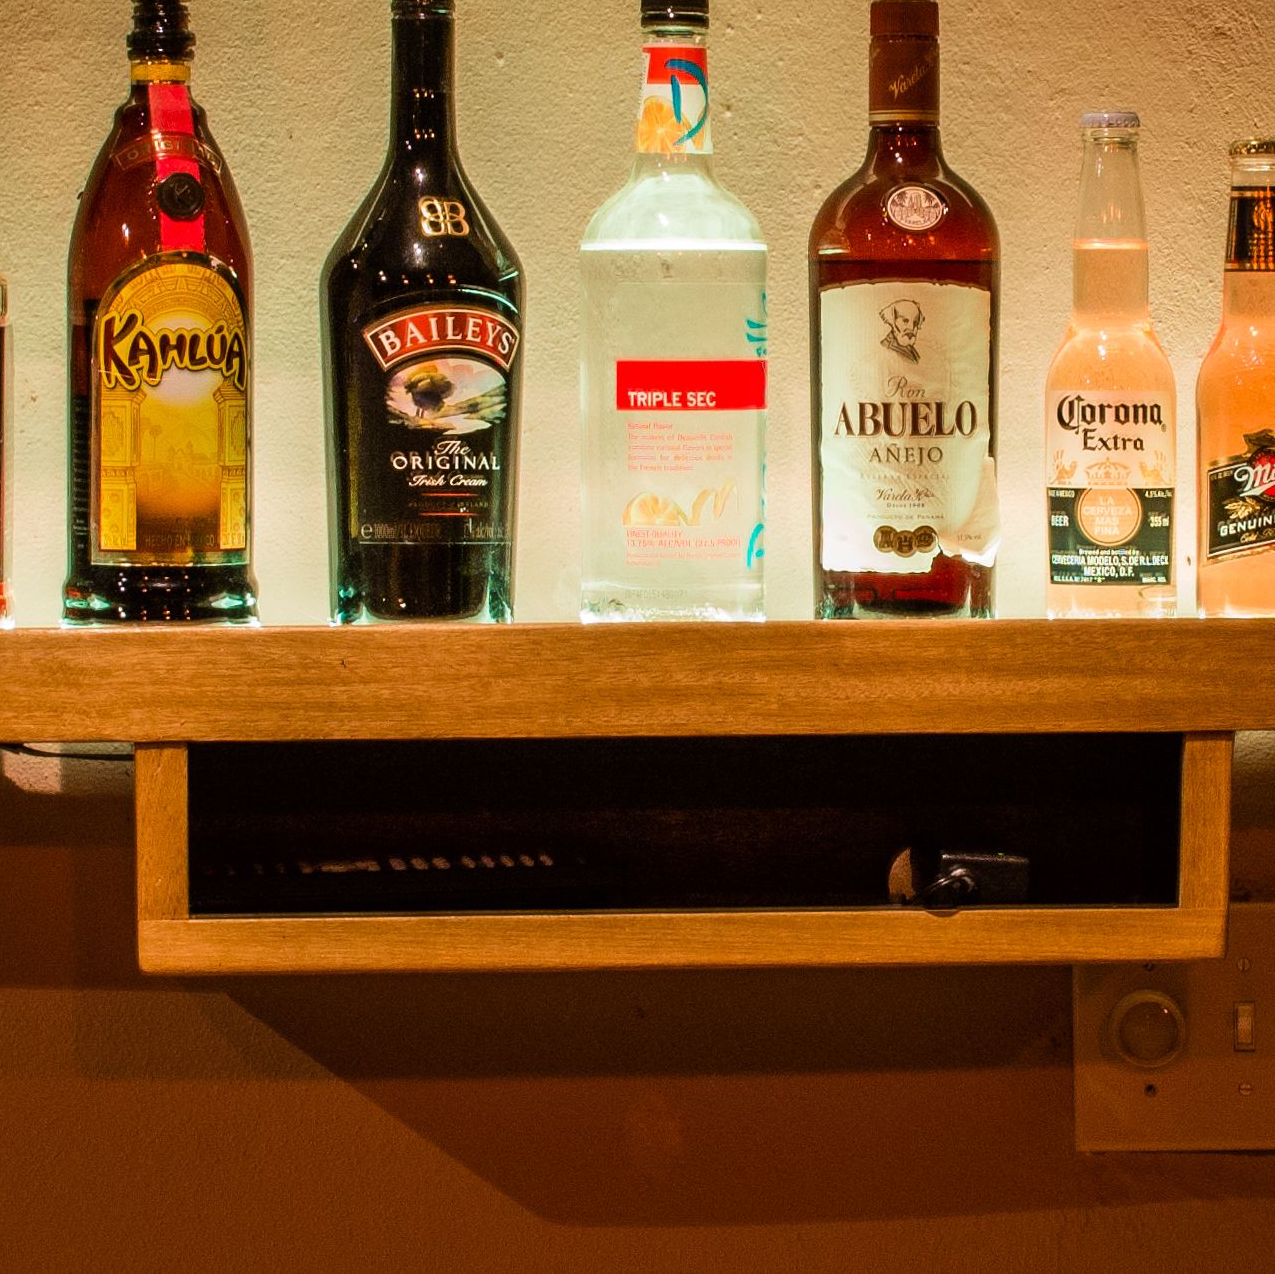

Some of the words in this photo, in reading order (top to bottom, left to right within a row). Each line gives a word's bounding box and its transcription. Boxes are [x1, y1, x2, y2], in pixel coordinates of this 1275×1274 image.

[378, 316, 515, 357] BAILEYS
[102, 312, 246, 388] KAHLÚA
[886, 374, 926, 399] Ron
[627, 391, 682, 407] TRIPLE
[685, 390, 716, 407] SEC
[833, 399, 978, 439] ABUELO
[1056, 393, 1164, 434] Corona
[433, 439, 472, 457] The
[1082, 427, 1145, 452] Extra
[392, 455, 502, 471] ORIGINAL
[868, 443, 944, 465] AÑEJO
[408, 473, 446, 487] Irish
[449, 474, 489, 487] Cream
[1098, 496, 1115, 506] LA
[1083, 506, 1133, 516] CERVEZA
[1094, 516, 1120, 526] MAS
[1094, 526, 1120, 536] FINA
